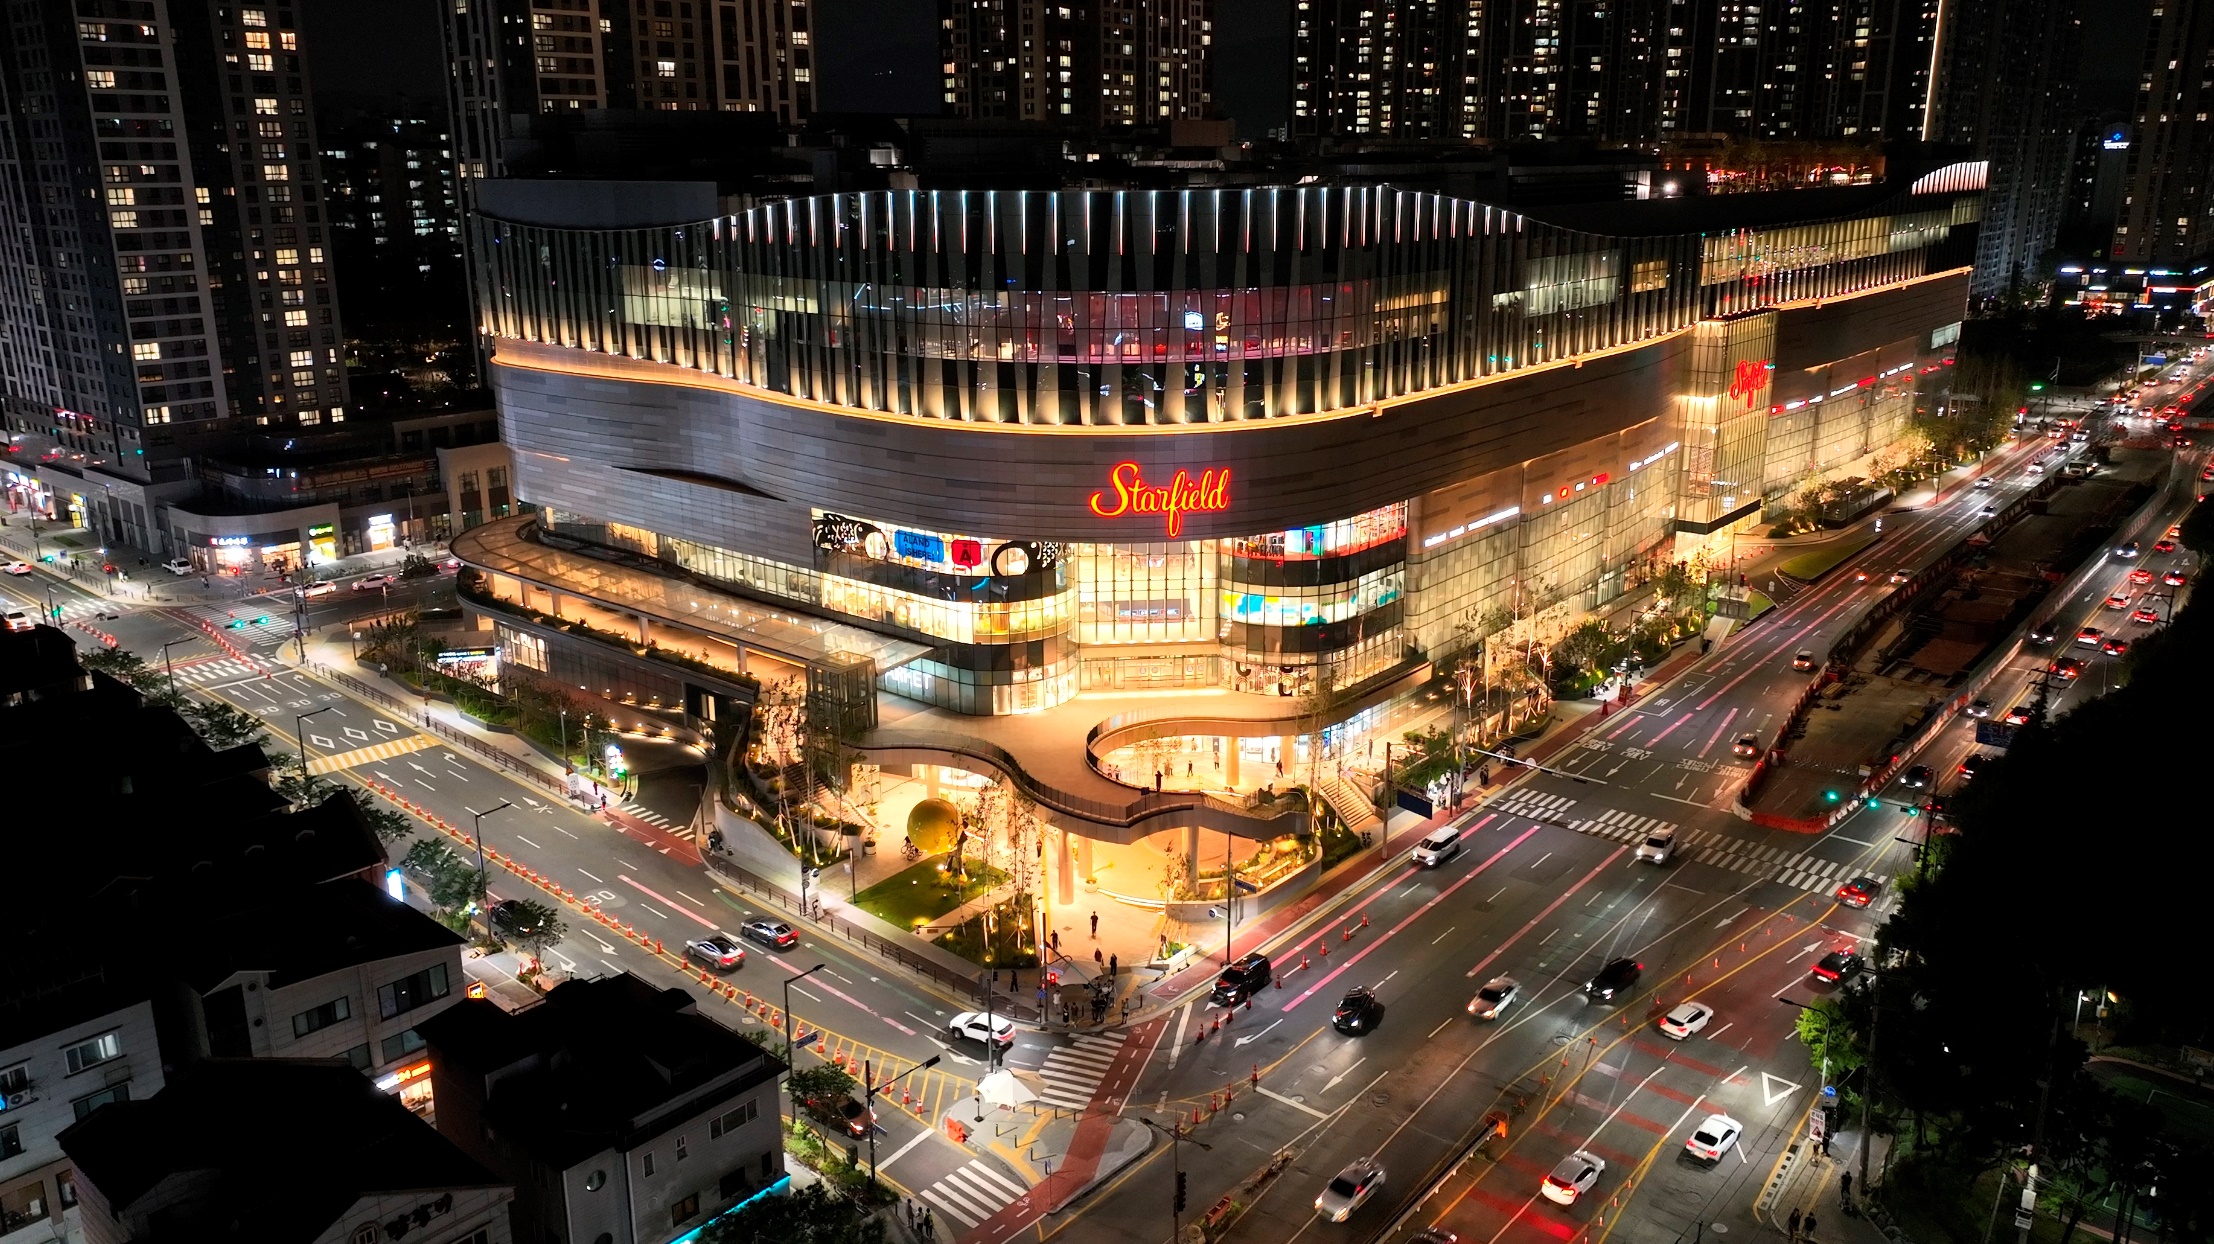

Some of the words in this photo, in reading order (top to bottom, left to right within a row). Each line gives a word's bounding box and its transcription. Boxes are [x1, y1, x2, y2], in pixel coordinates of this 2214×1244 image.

[1090, 462, 1230, 538] Starfield
[317, 692, 342, 701] 30
[287, 699, 312, 708] 30
[255, 706, 280, 716] 30
[585, 890, 616, 905] 30
